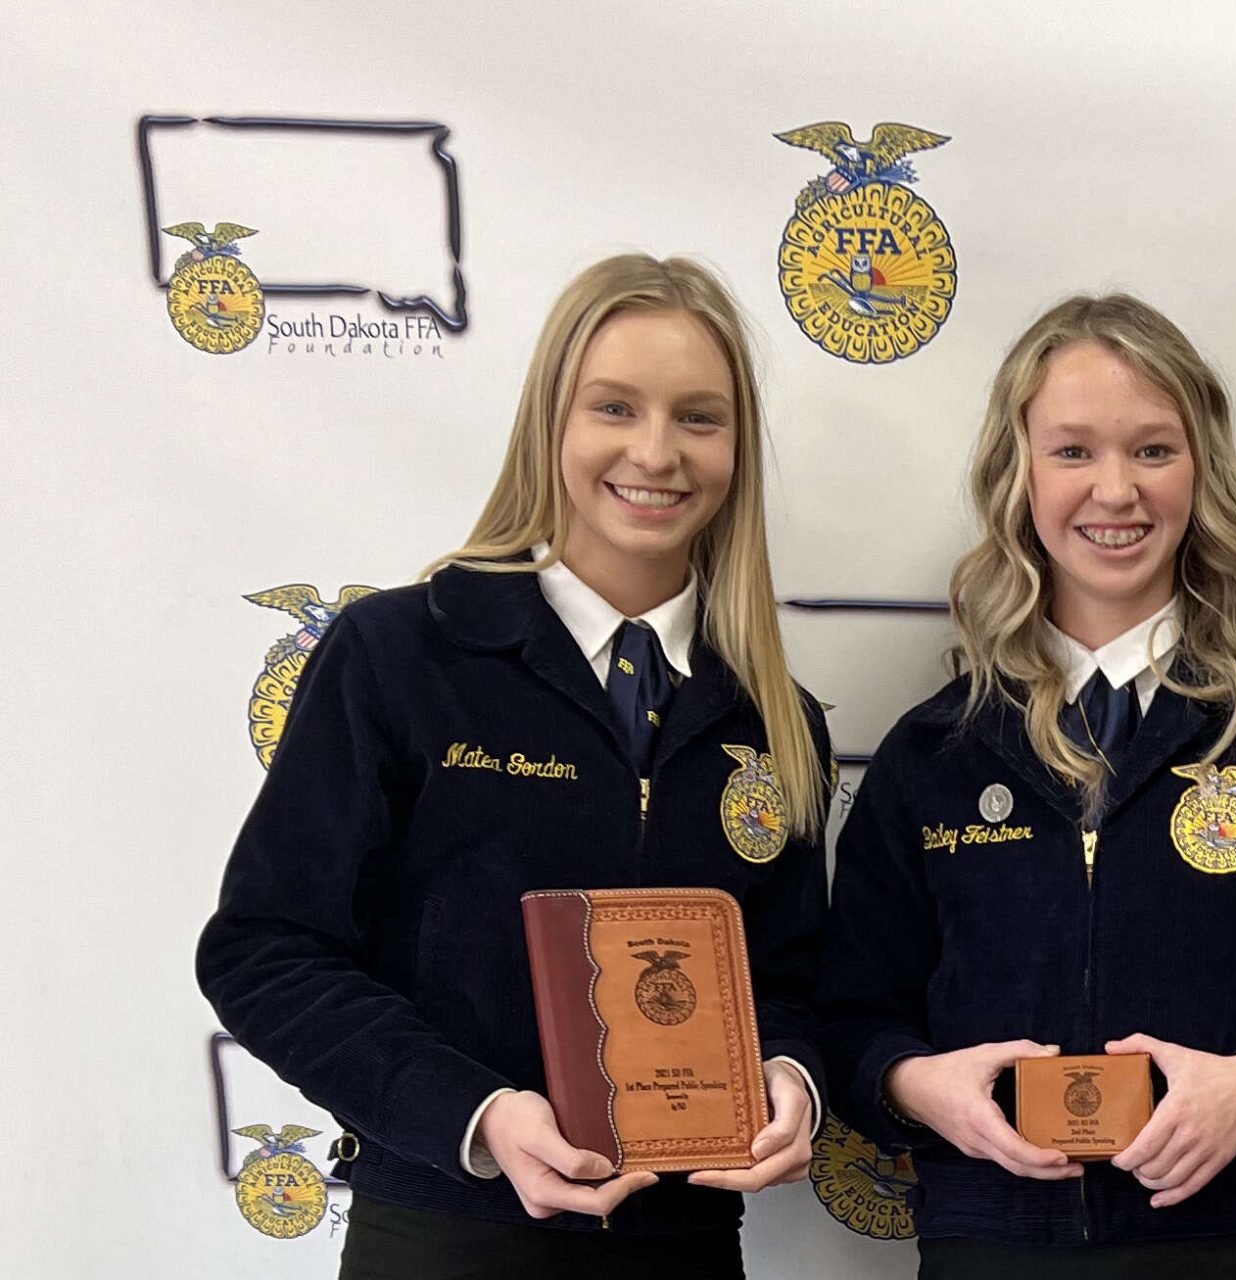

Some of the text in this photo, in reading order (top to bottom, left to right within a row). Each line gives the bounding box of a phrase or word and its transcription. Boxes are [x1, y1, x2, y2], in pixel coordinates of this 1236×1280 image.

[806, 203, 930, 259] AGRICULTURAL
[834, 228, 903, 255] FFA
[198, 280, 235, 295] FFA
[266, 313, 442, 339] South Dakota FFA
[817, 301, 921, 338] EDUCATION
[267, 336, 445, 358] Foundation
[507, 752, 579, 780] Gordon
[265, 1174, 299, 1187] FFA
